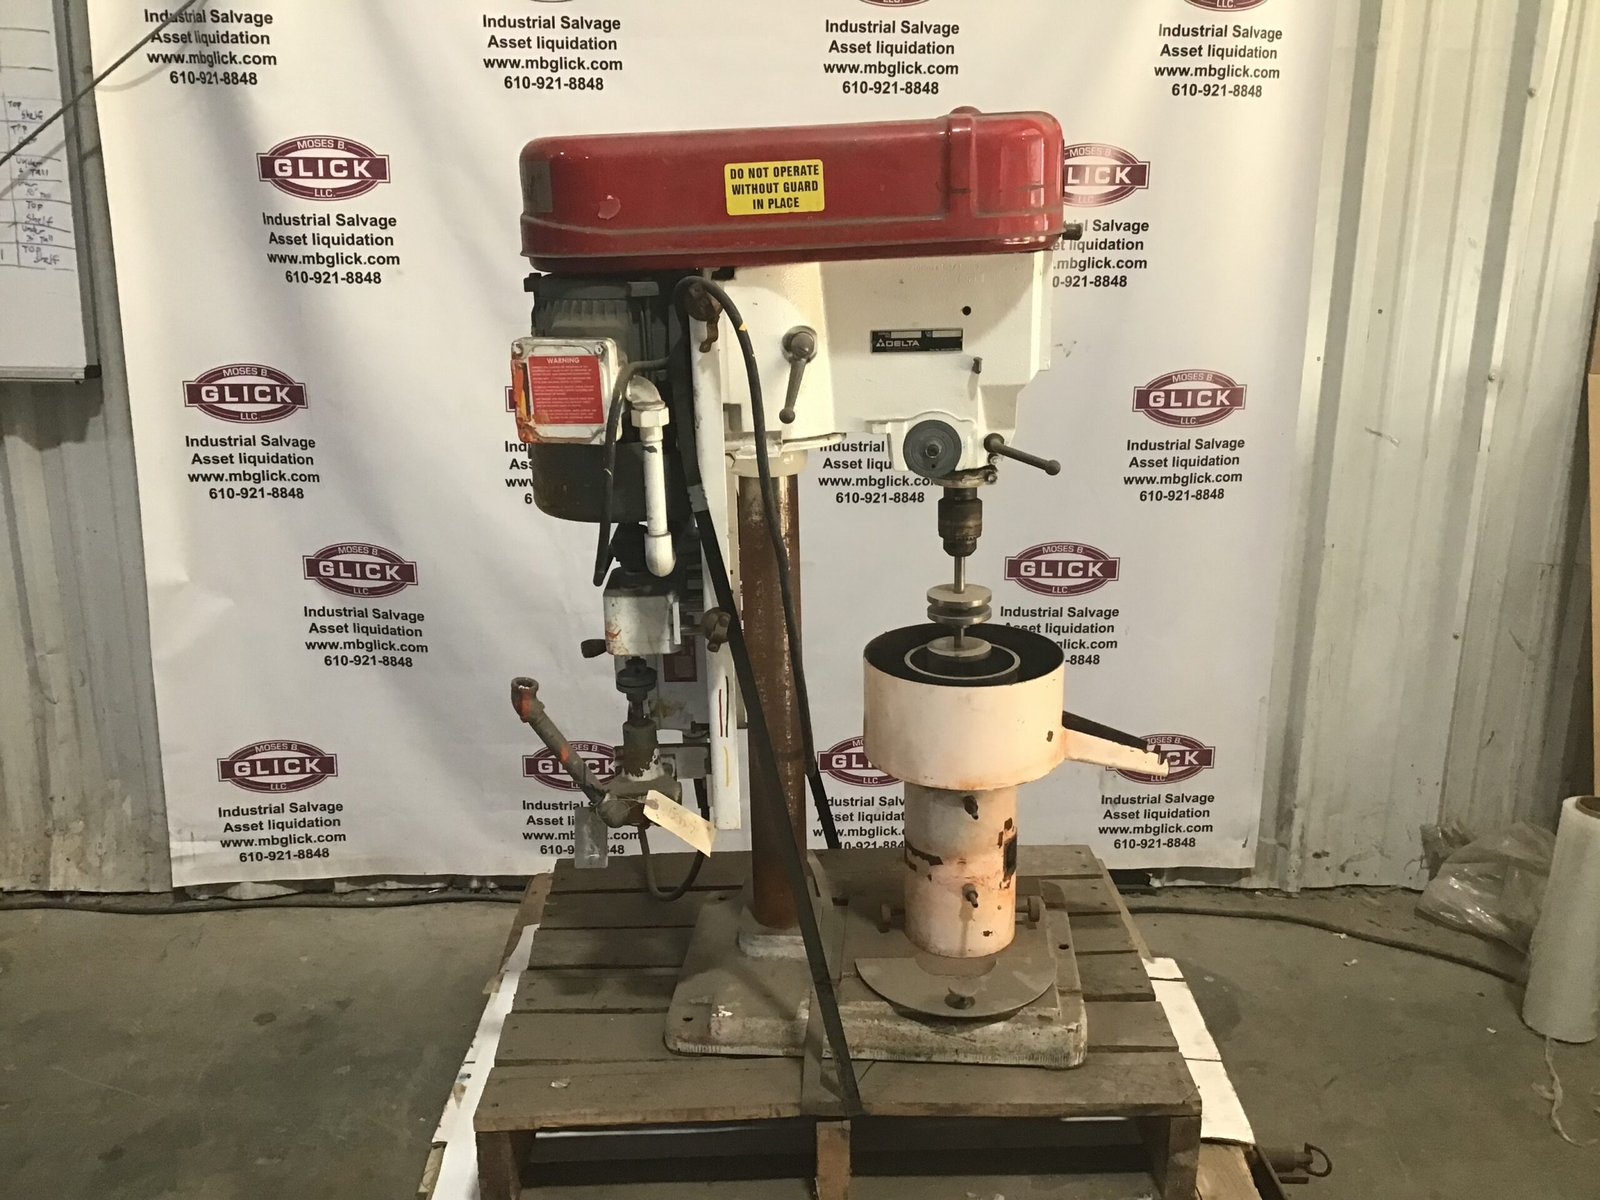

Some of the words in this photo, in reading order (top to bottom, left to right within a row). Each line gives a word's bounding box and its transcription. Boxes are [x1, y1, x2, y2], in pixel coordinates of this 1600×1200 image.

[210, 10, 273, 27] Salvage
[482, 15, 555, 29] Industrial
[561, 16, 621, 33] Salvage
[826, 19, 895, 33] Industrial
[901, 20, 960, 37] Salvage
[1159, 24, 1228, 37] Industrial
[1232, 25, 1283, 42] Salvage
[151, 31, 192, 44] Asset
[194, 31, 270, 47] liquidation
[488, 35, 532, 49] Asset
[537, 36, 617, 52] liquidation
[829, 40, 871, 53] Asset
[877, 41, 954, 57] liquidation
[1160, 44, 1203, 57] Asset
[1208, 45, 1277, 60] liquidation
[147, 51, 277, 68] www.mbglick.com
[483, 57, 623, 73] www.mbglick.com
[824, 61, 958, 77] www.mbglick.com
[1154, 64, 1280, 80] www.mbglick.com
[170, 71, 257, 85] 610-921-8848
[504, 76, 604, 90] 610-921-8848
[842, 81, 939, 94] 610-921-8848
[1172, 84, 1262, 97] 610-921-8848
[297, 140, 334, 149] MOSES
[338, 141, 347, 150] B.
[1070, 148, 1101, 157] MOSES
[274, 159, 371, 177] GLICK
[730, 168, 743, 179] DO
[748, 167, 769, 178] NOT
[773, 165, 819, 177] OPERATE
[1068, 167, 1132, 183] LICK
[315, 189, 335, 197] LLC.
[732, 183, 779, 195] WITHOUT
[783, 181, 818, 192] GUARD
[753, 199, 763, 209] IN
[768, 197, 799, 209] PLACE
[263, 212, 330, 226] Industrial
[336, 214, 397, 229] Salvage
[1092, 219, 1149, 234] Salvage
[269, 232, 307, 245] Asset
[312, 233, 394, 248] liquidation
[1070, 239, 1143, 252] liquidation
[267, 252, 400, 267] www.mbglick.com
[1053, 257, 1147, 271] .mbglick.com
[286, 271, 382, 284] 610-921-8848
[1052, 275, 1127, 287] 0-921-8848
[222, 367, 258, 377] MOSES
[1172, 373, 1203, 382] MOSES
[201, 386, 292, 402] GLICK
[1149, 390, 1231, 407] GLICK
[185, 435, 256, 447] Industrial
[261, 435, 316, 450] Salvage
[1127, 439, 1191, 451] Industrial
[1195, 438, 1244, 451] Salvage
[191, 453, 234, 465] Asset
[239, 453, 314, 466] liquidation
[823, 458, 862, 469] Asset
[1129, 457, 1168, 467] Asset
[1172, 455, 1240, 469] liquidation
[188, 470, 320, 484] www.mbglick.com
[818, 476, 934, 489] www.mbglick.co
[1124, 473, 1242, 486] www.mbglick.com
[209, 487, 304, 499] 610-921-8848
[836, 492, 924, 503] 610-921-8848
[1140, 489, 1224, 501] 610-921-8848
[338, 546, 368, 554] MOSES
[1042, 546, 1074, 554] MOSES
[319, 561, 401, 580] GLICK
[1020, 562, 1104, 577] GLICK
[304, 606, 368, 618] Industrial
[372, 608, 425, 624] Salvage
[1000, 606, 1063, 618] Industrial
[1067, 606, 1119, 620] Salvage
[309, 623, 348, 634] Asset
[353, 623, 422, 637] liquidation
[1045, 623, 1114, 635] liquidation
[305, 639, 428, 652] www.mbglick.com
[324, 655, 412, 667] 610-921-8848
[255, 743, 288, 753] MOSES
[234, 759, 321, 776] GLICK
[538, 760, 615, 774] GLCK
[815, 797, 874, 806] dustrial
[879, 797, 904, 806] Salv
[1101, 794, 1160, 804] Industrial
[1165, 794, 1215, 805] Salvage
[218, 803, 284, 817] Industrial
[289, 802, 343, 814] Salvage
[1103, 810, 1140, 819] Asset
[1144, 808, 1210, 820] liquidation
[526, 815, 563, 825] Asset
[858, 812, 905, 823] liquidat
[224, 821, 264, 833] Asset
[268, 817, 340, 831] liquidation
[1098, 824, 1213, 836] www.mbglick.com
[220, 833, 346, 848] www.mbglick.com
[1114, 838, 1195, 848] 610-921-8848
[239, 848, 330, 862] 610-921-8848
